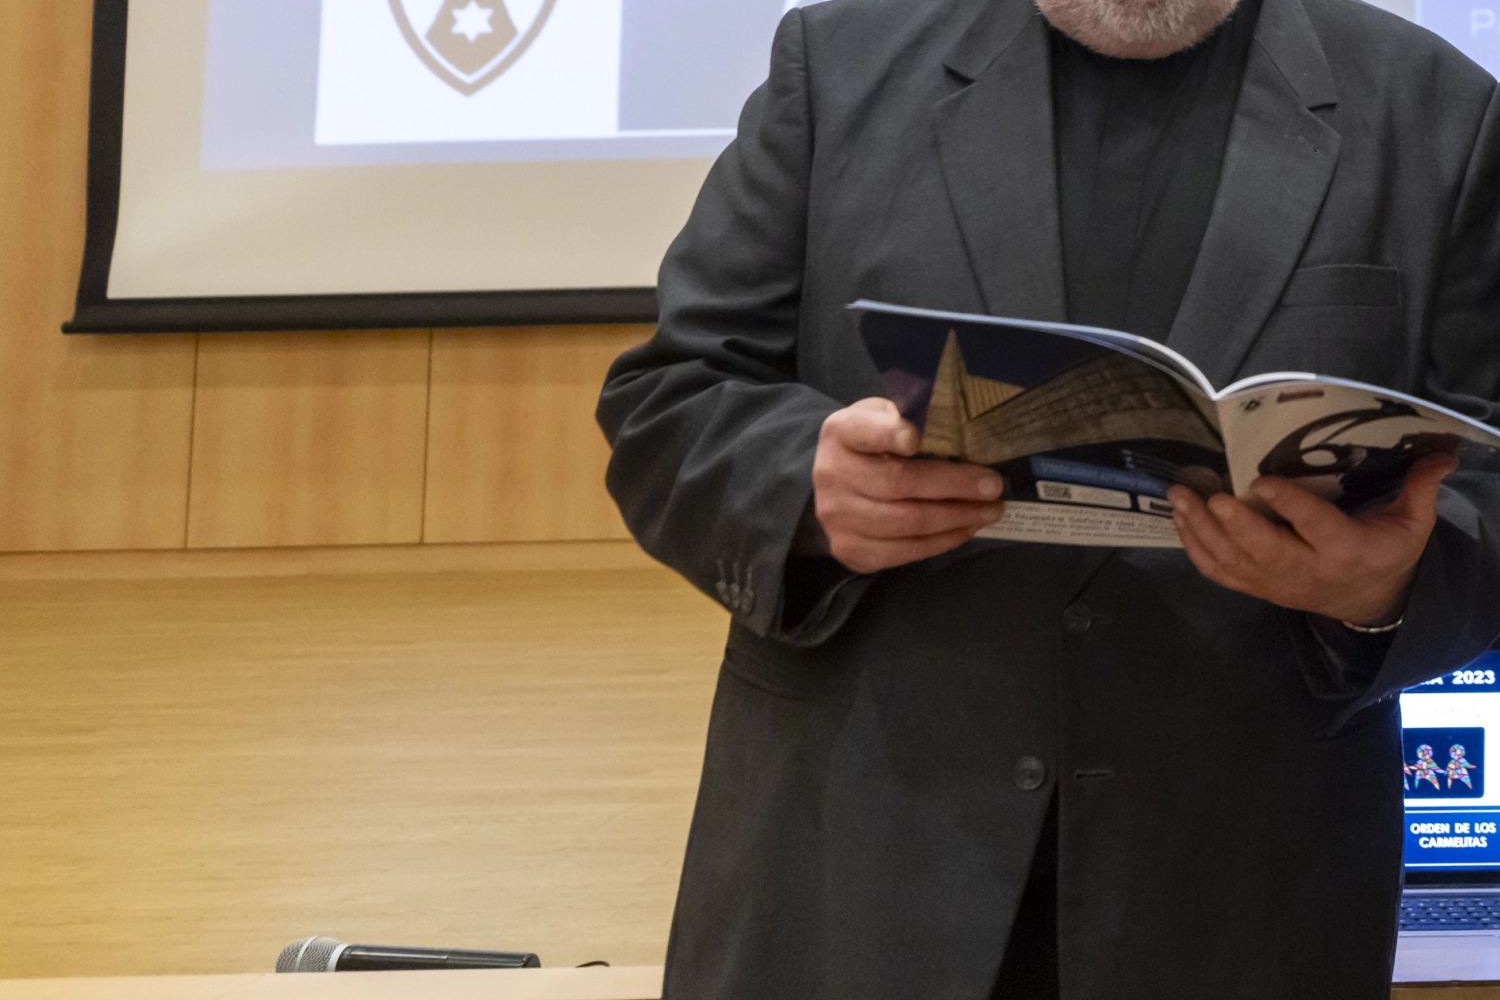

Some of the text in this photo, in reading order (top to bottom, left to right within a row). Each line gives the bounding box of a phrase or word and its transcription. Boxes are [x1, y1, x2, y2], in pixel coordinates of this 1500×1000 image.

[1451, 669, 1496, 685] 2023
[1409, 822, 1497, 834] ORDEN DE LOS
[1418, 836, 1488, 849] CARMELITAS
